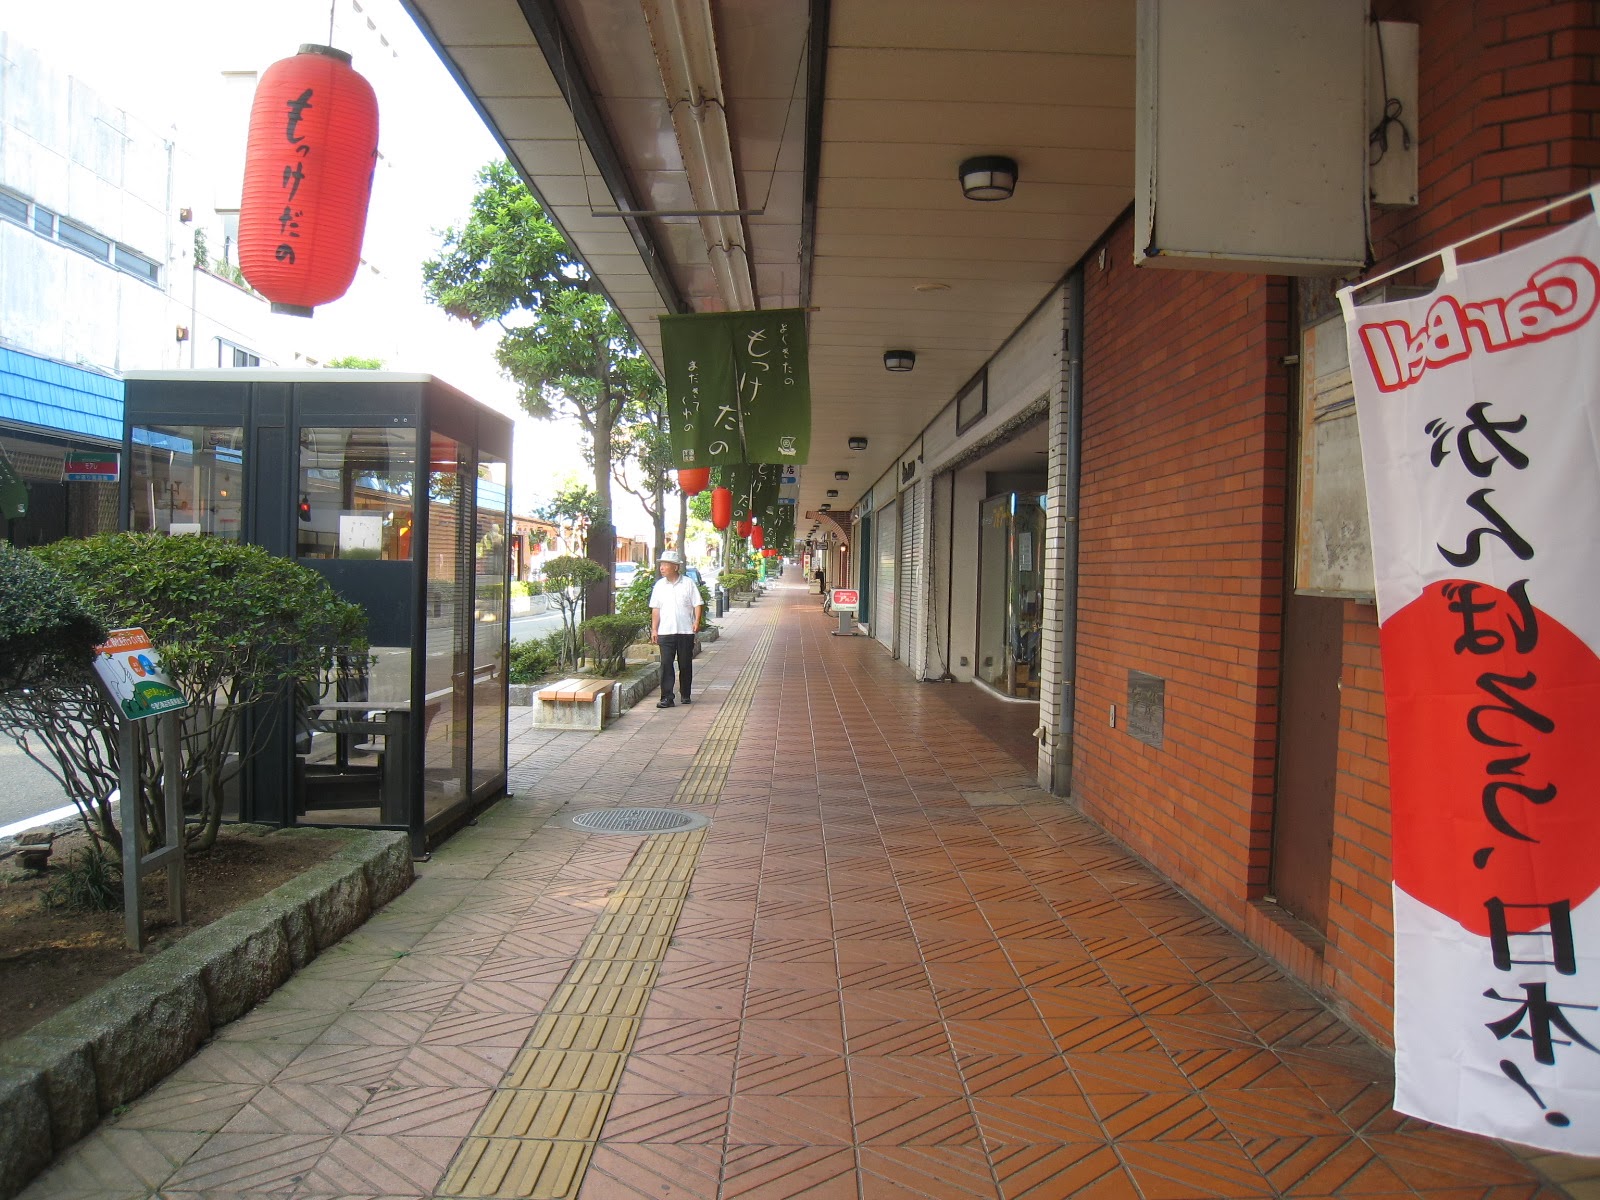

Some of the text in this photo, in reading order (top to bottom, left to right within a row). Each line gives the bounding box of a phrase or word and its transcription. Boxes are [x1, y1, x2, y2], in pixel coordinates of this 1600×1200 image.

[275, 88, 314, 265] もっけだの
[708, 328, 772, 455] もっけだの
